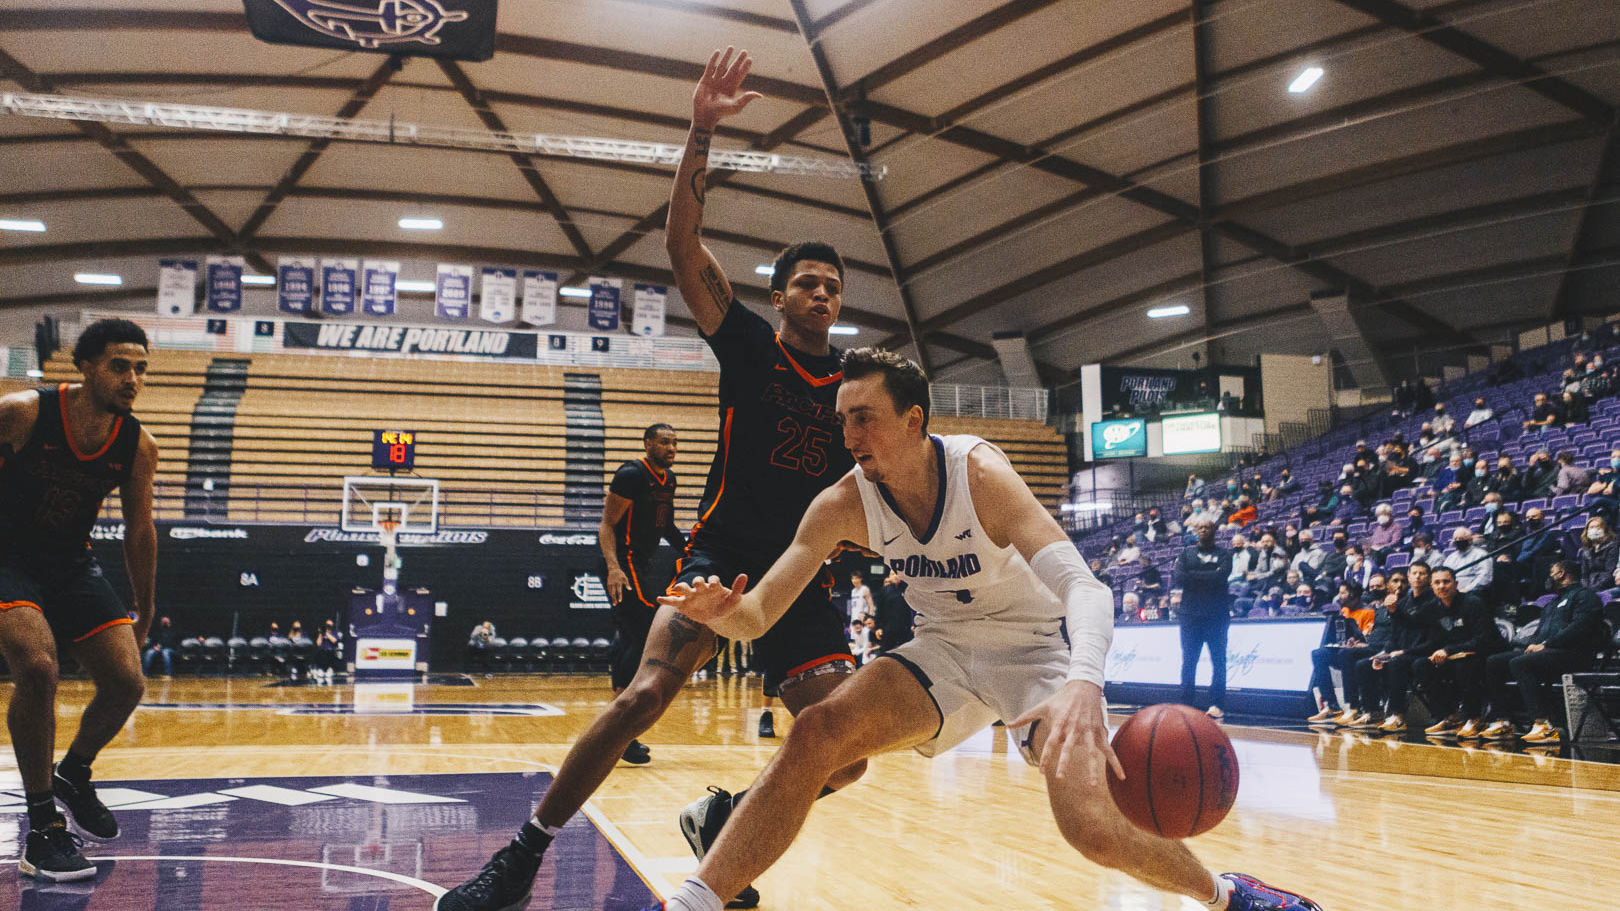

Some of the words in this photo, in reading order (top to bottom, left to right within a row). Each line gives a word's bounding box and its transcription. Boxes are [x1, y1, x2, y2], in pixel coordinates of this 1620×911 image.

[317, 324, 357, 347] WE
[354, 327, 398, 350] ARE
[400, 328, 509, 354] PORTLAND
[1120, 376, 1176, 391] PORTLAND
[1129, 389, 1168, 405] PILOTS
[770, 416, 833, 477] 25
[890, 553, 981, 579] PORTLAND
[240, 573, 259, 586] 8A
